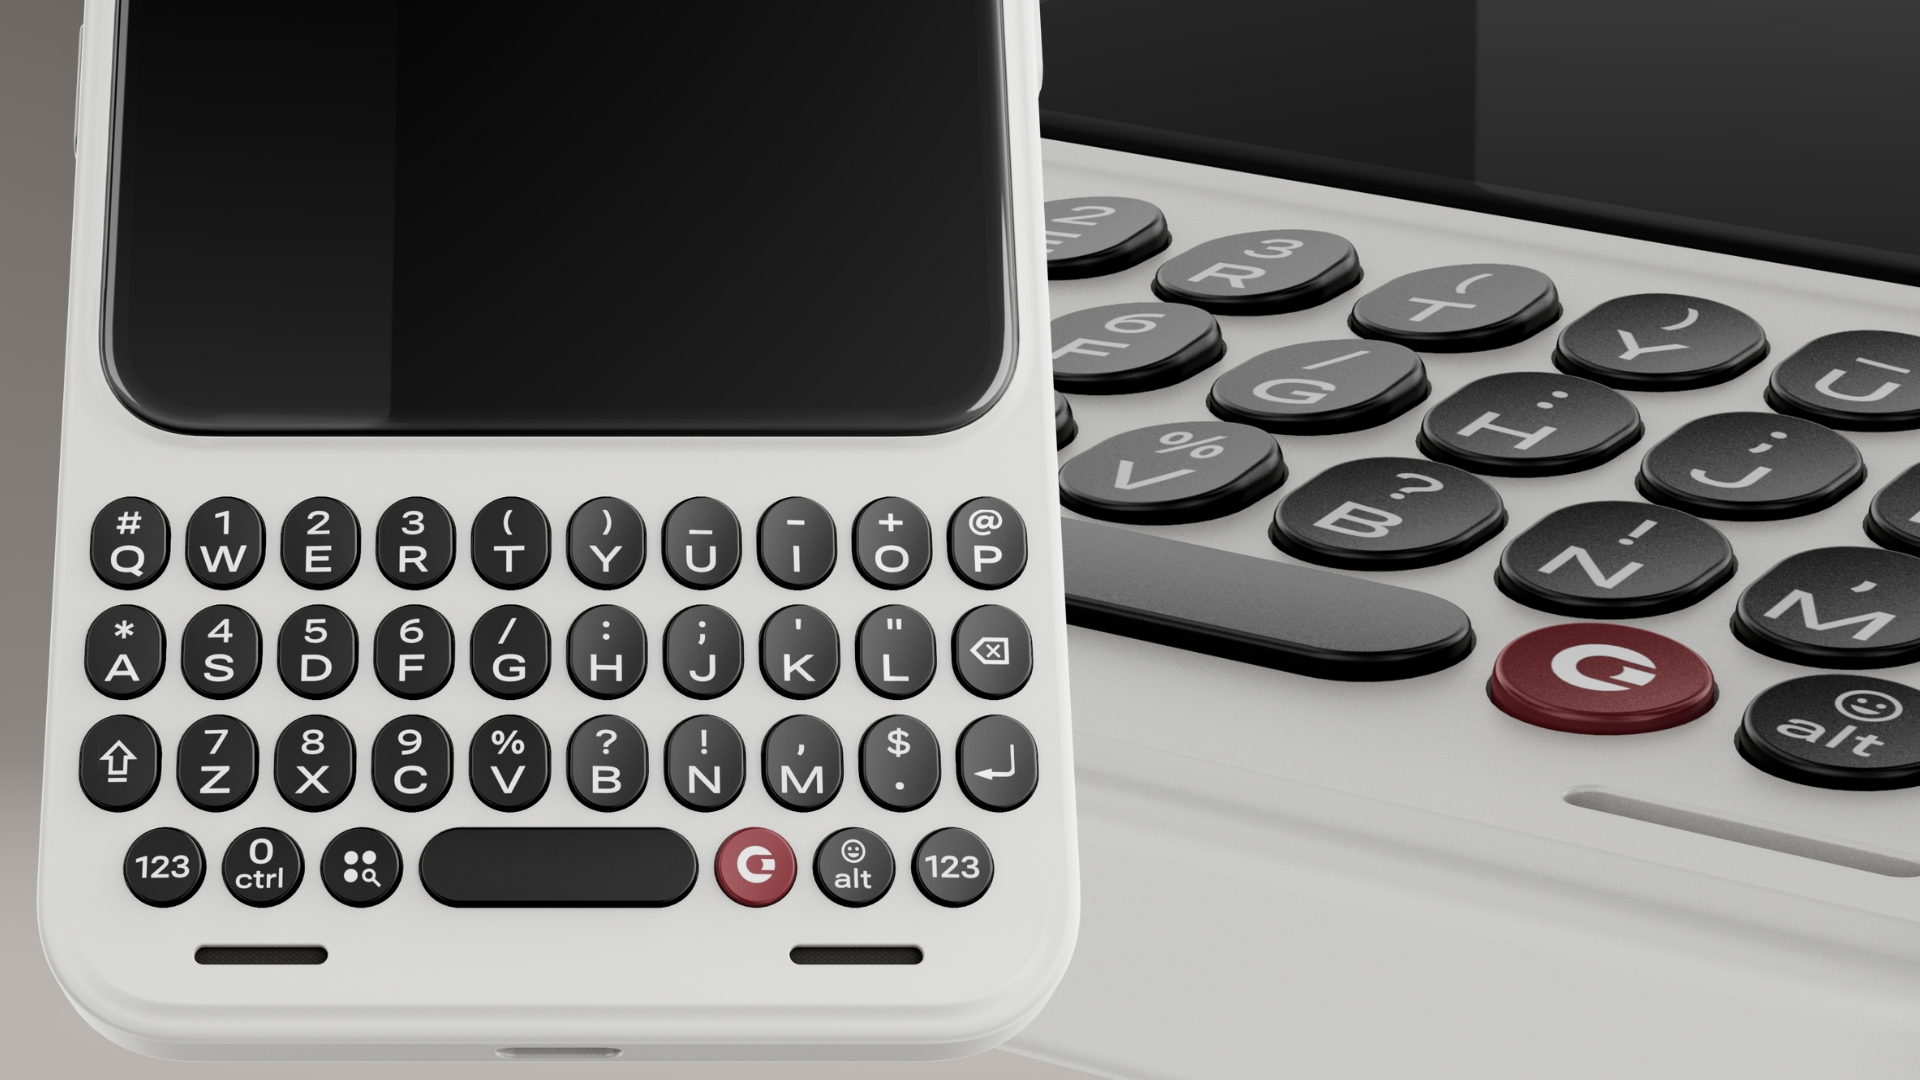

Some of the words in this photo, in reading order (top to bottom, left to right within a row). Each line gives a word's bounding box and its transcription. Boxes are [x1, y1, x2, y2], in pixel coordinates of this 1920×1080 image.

[1051, 205, 1116, 226] 2
[1243, 238, 1304, 259] 3
[1187, 262, 1266, 289] R
[1455, 273, 1494, 295] (
[1104, 313, 1166, 334] 6
[1408, 297, 1477, 322] T
[1661, 307, 1699, 331] )
[1617, 329, 1690, 361] Y
[1302, 350, 1370, 370] /
[1252, 378, 1336, 405] G
[1814, 368, 1901, 402] U
[1155, 431, 1227, 459] %
[1456, 411, 1558, 451] H
[1114, 459, 1196, 490] V
[1389, 472, 1444, 500] ?
[1690, 465, 1773, 489] J
[116, 510, 142, 535] #
[214, 510, 230, 535] 1
[306, 510, 331, 535] 2
[401, 510, 425, 536] 3
[504, 510, 512, 535] (
[603, 510, 611, 535] )
[878, 512, 904, 532] +
[968, 509, 1003, 536] @
[1312, 500, 1403, 539] B
[1618, 519, 1658, 546] !
[110, 544, 145, 577] Q
[199, 544, 247, 573] W
[305, 545, 332, 573] E
[399, 545, 429, 573] R
[493, 545, 525, 573] T
[589, 544, 623, 573] Y
[685, 544, 717, 573] U
[793, 546, 800, 572] I
[874, 544, 910, 573] O
[973, 544, 1003, 573] P
[1538, 545, 1644, 590] N
[1763, 589, 1897, 642] M
[207, 618, 233, 643] 4
[304, 618, 328, 644] 5
[399, 618, 424, 644] 6
[498, 617, 517, 645] /
[603, 621, 610, 640] :
[699, 621, 706, 645] ;
[104, 653, 140, 682] A
[203, 653, 235, 683] S
[300, 654, 333, 682] D
[398, 653, 425, 682] F
[492, 653, 526, 682] G
[590, 653, 623, 682] H
[689, 654, 716, 682] J
[783, 653, 816, 682] K
[882, 653, 910, 682] L
[204, 729, 229, 755] 7
[301, 729, 325, 755] 8
[397, 729, 422, 756] 9
[491, 729, 525, 755] %
[595, 729, 618, 755] ?
[701, 730, 707, 754] !
[887, 727, 911, 758] $
[1776, 718, 1885, 758] alt
[199, 765, 231, 794] Z
[294, 765, 330, 794] X
[393, 765, 428, 795] C
[490, 765, 526, 794] V
[592, 765, 622, 794] B
[688, 765, 721, 794] N
[780, 765, 824, 794] M
[135, 854, 190, 879] 123
[235, 867, 284, 889] ctrl
[834, 867, 872, 889] alt
[924, 854, 980, 879] 123
